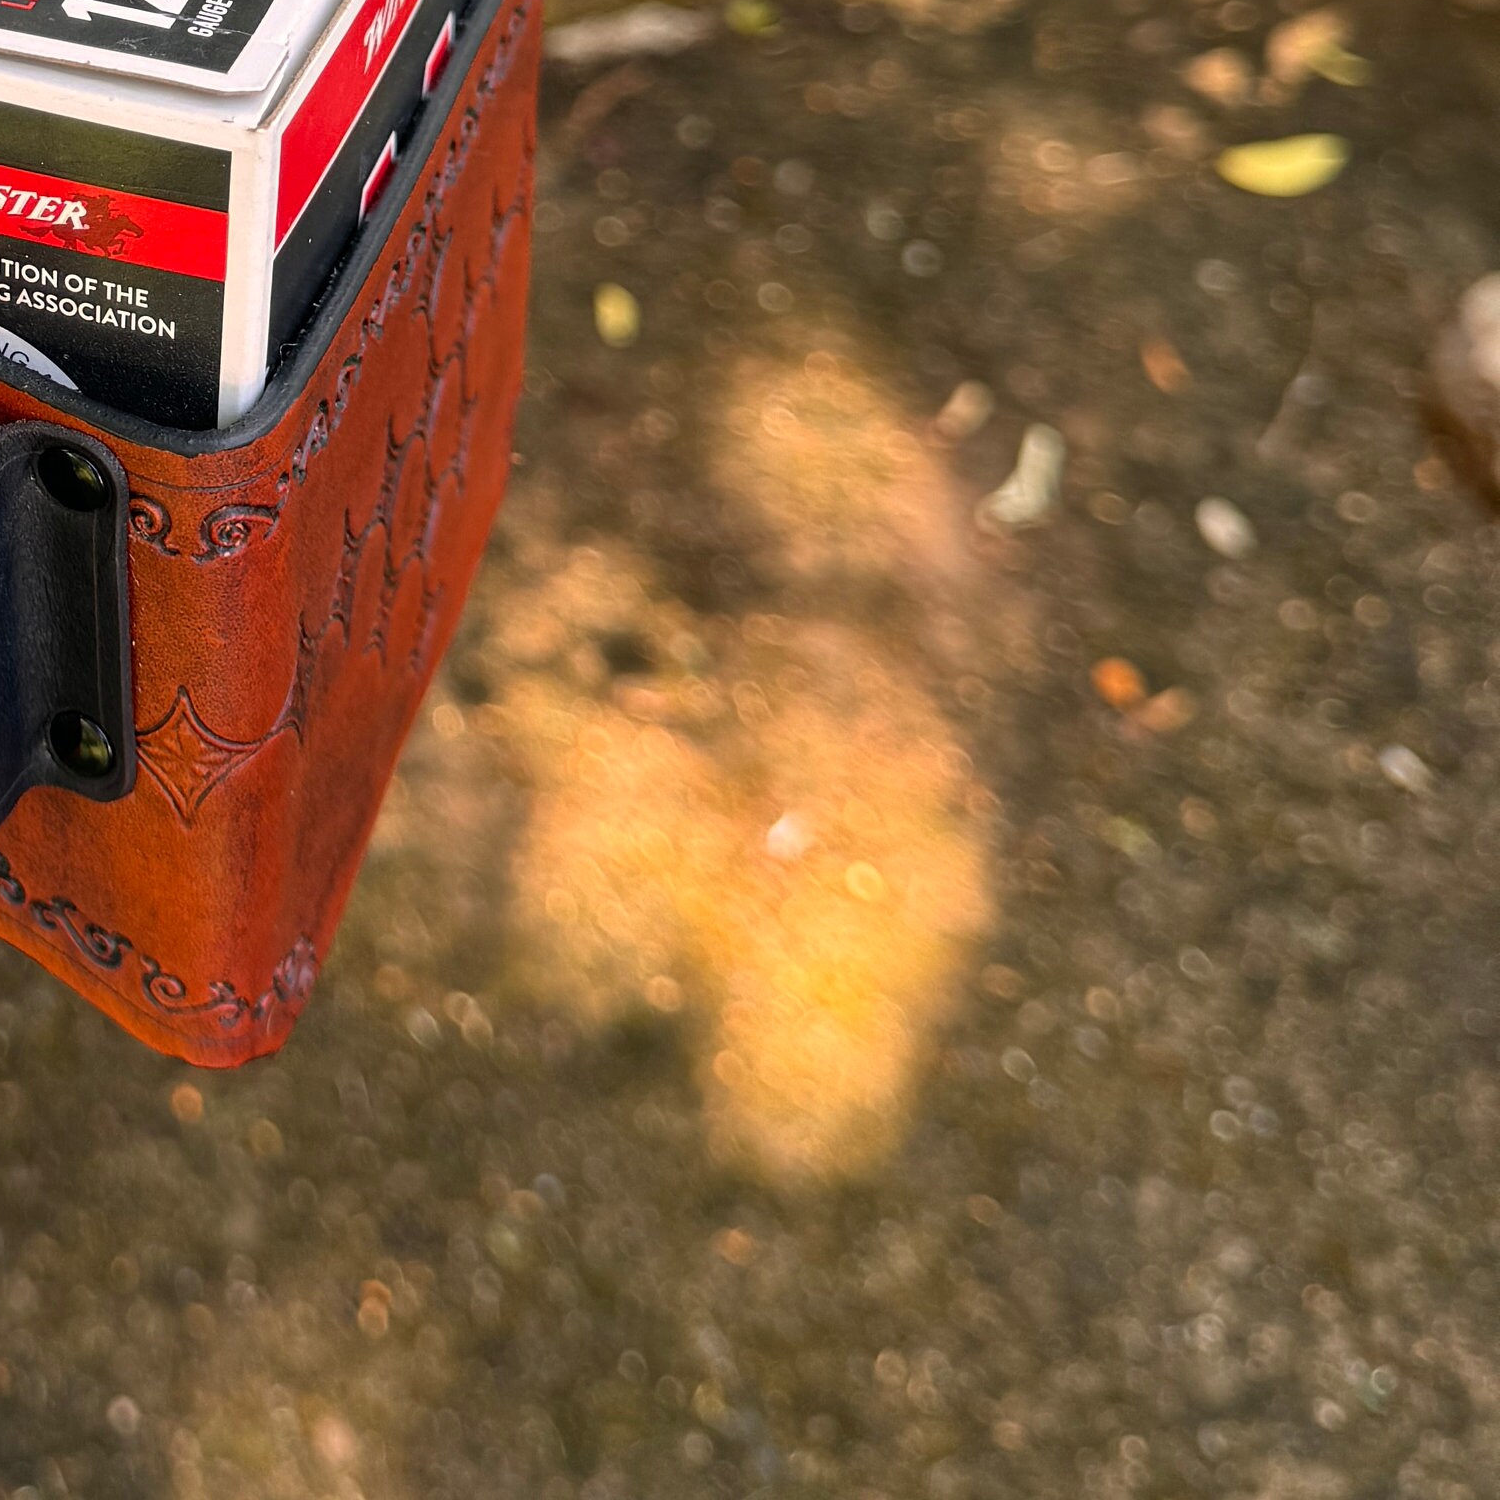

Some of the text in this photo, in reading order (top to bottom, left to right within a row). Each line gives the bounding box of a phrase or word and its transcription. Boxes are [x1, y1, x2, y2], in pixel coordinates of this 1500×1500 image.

[64, 273, 98, 296] OF
[103, 281, 149, 309] THE
[16, 288, 176, 340] ASSOCIATION
